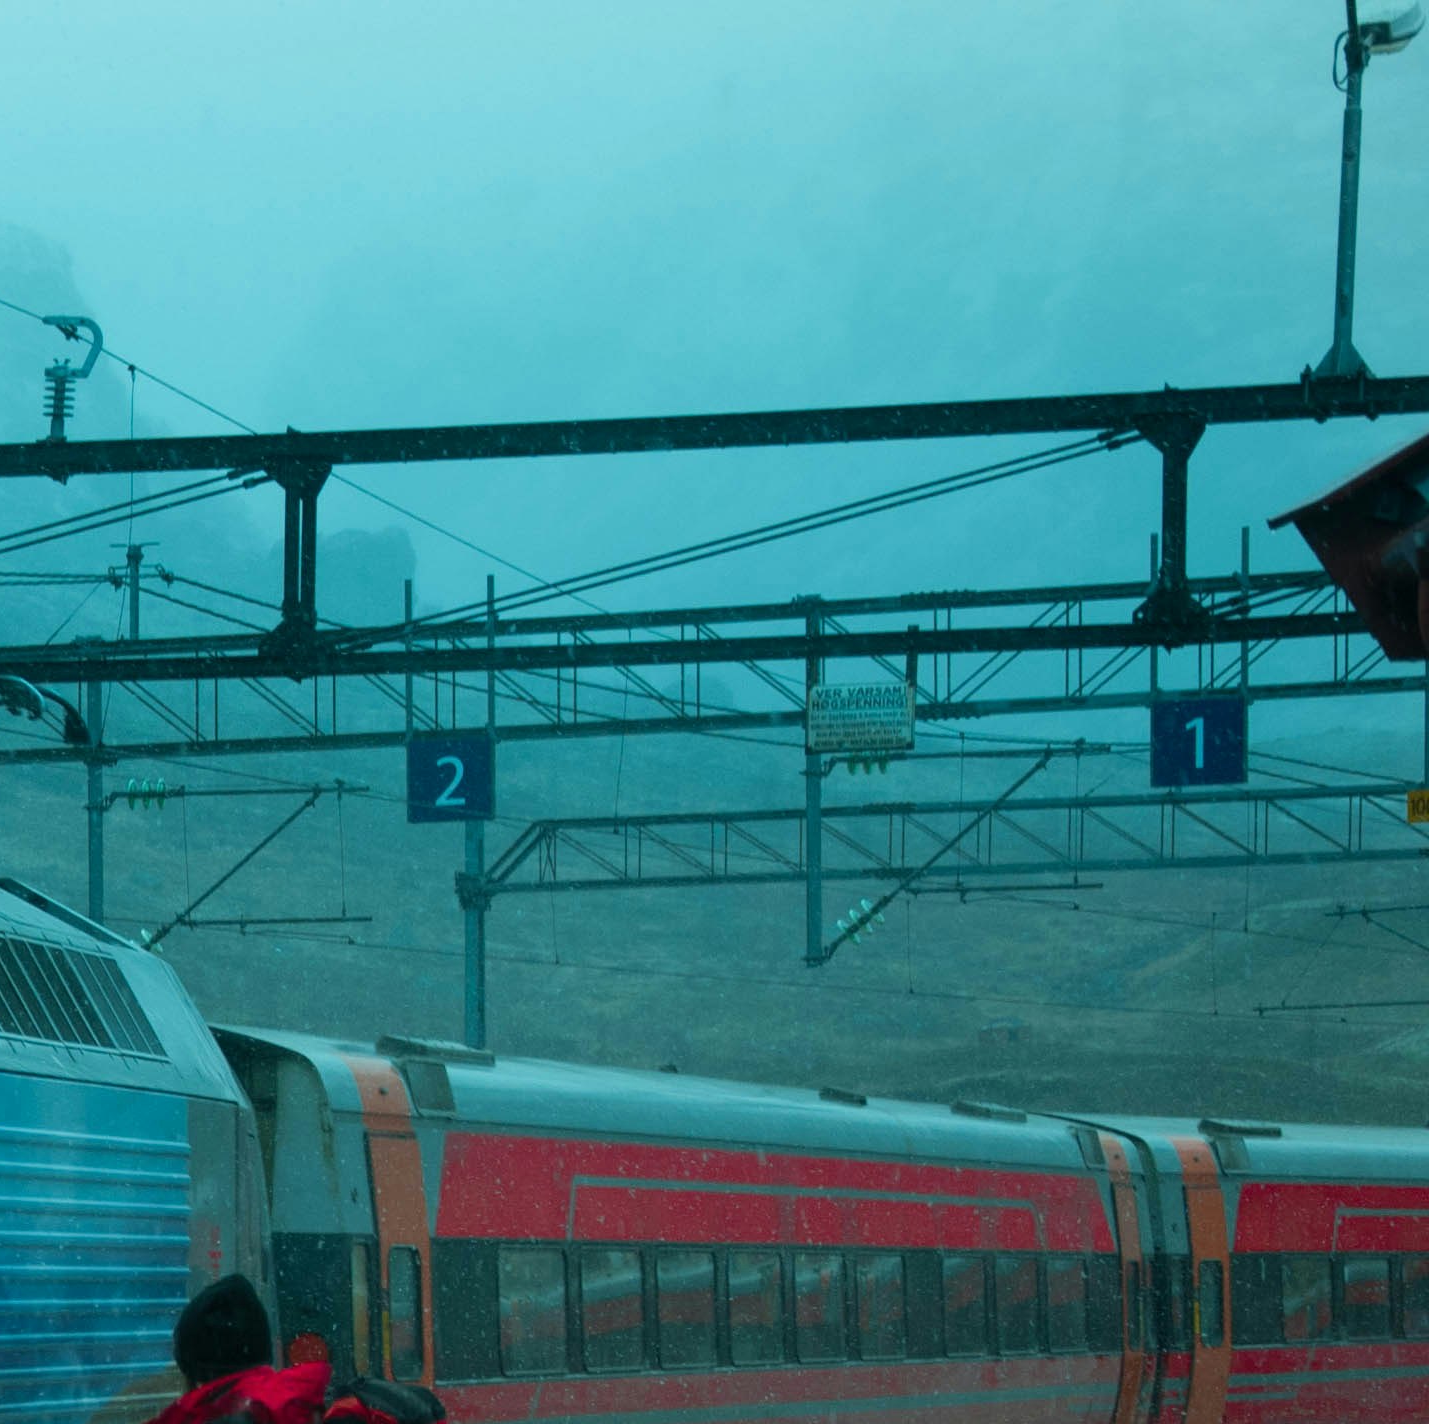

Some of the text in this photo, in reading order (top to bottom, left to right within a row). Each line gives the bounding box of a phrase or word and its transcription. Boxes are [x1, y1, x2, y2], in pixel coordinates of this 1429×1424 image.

[815, 687, 843, 699] VER
[1185, 717, 1204, 768] 1
[435, 756, 466, 806] 2
